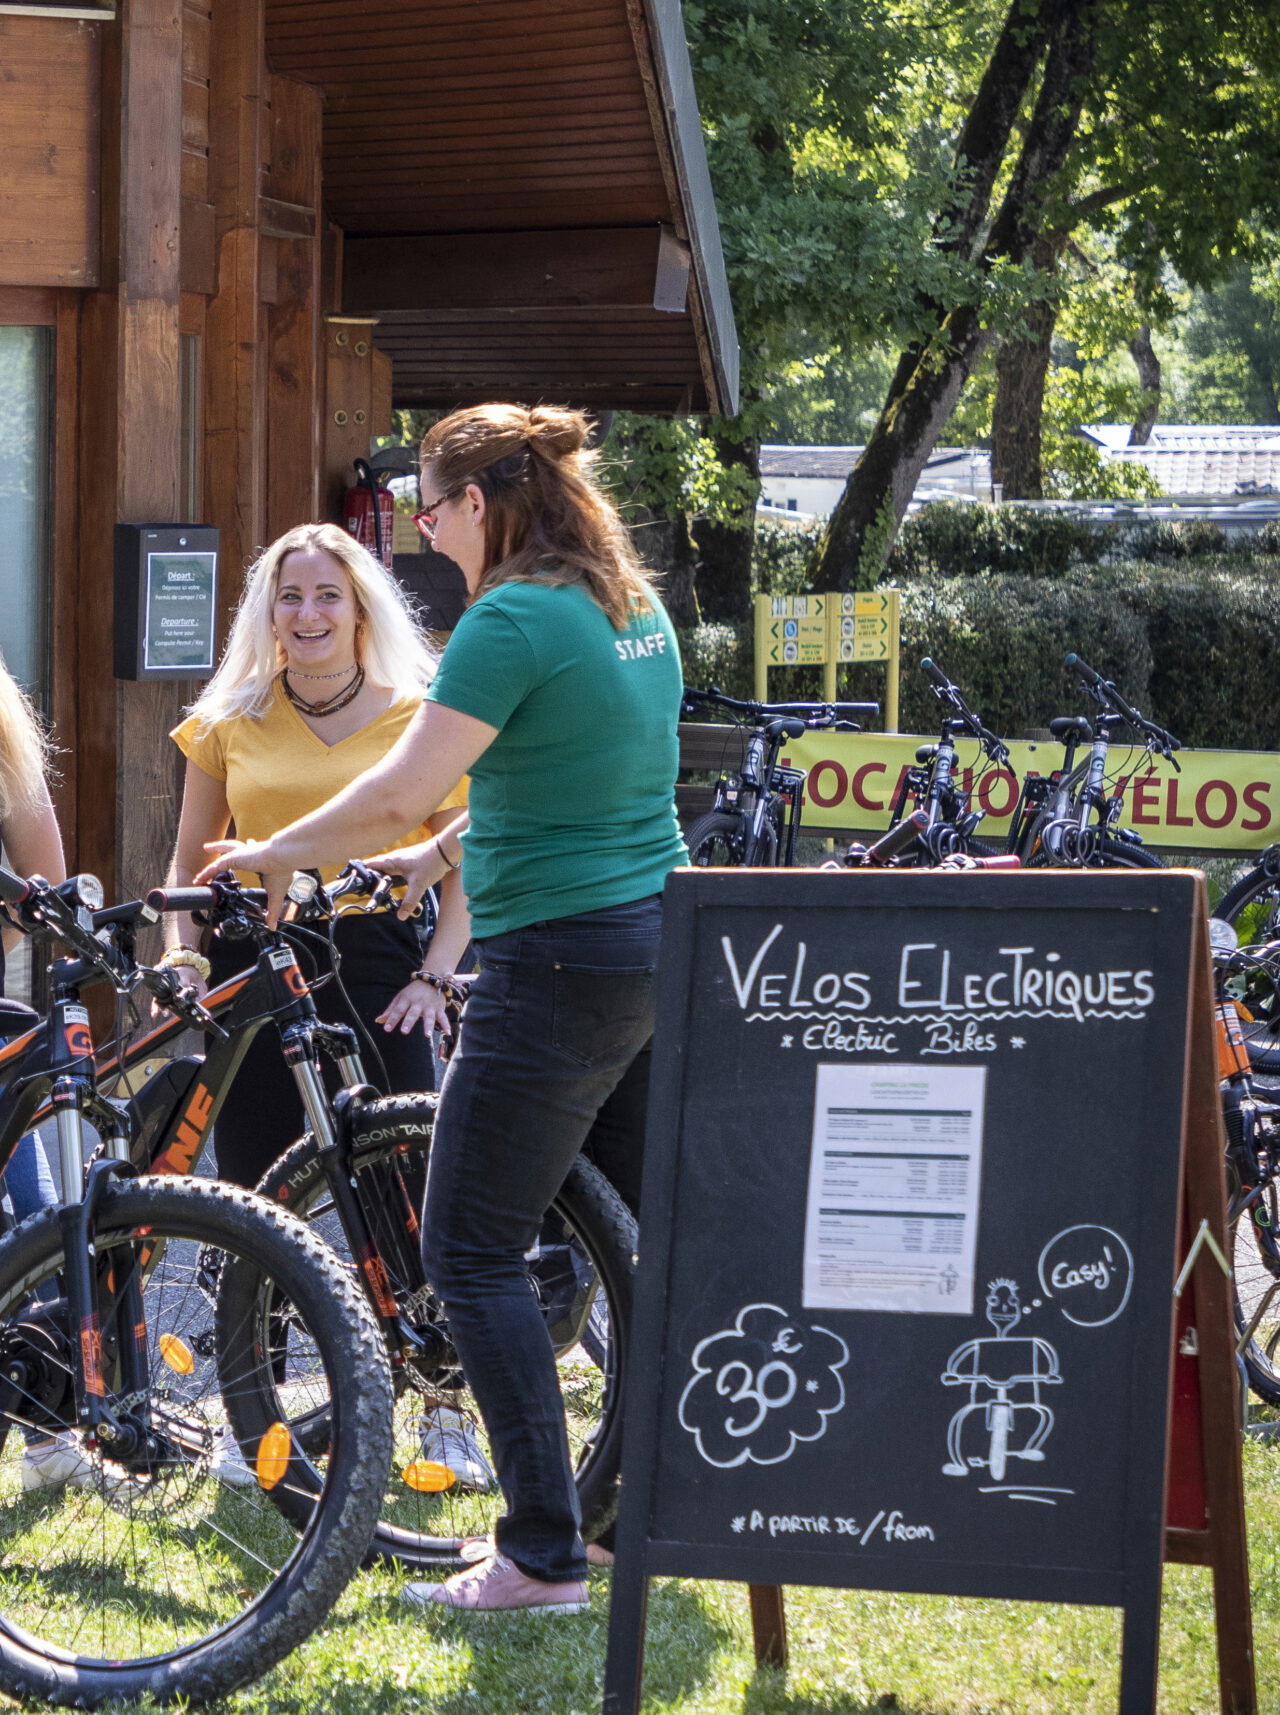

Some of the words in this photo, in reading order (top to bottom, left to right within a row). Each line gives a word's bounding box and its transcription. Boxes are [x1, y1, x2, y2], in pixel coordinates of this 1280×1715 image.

[615, 633, 665, 660] STAFF
[722, 924, 870, 1009] VELOS
[803, 1022, 899, 1052] Electric
[920, 1022, 997, 1054] Bikes
[399, 1124, 435, 1135] TAIP
[1051, 1246, 1117, 1290] Easy!
[769, 1514, 831, 1538] PARTIR
